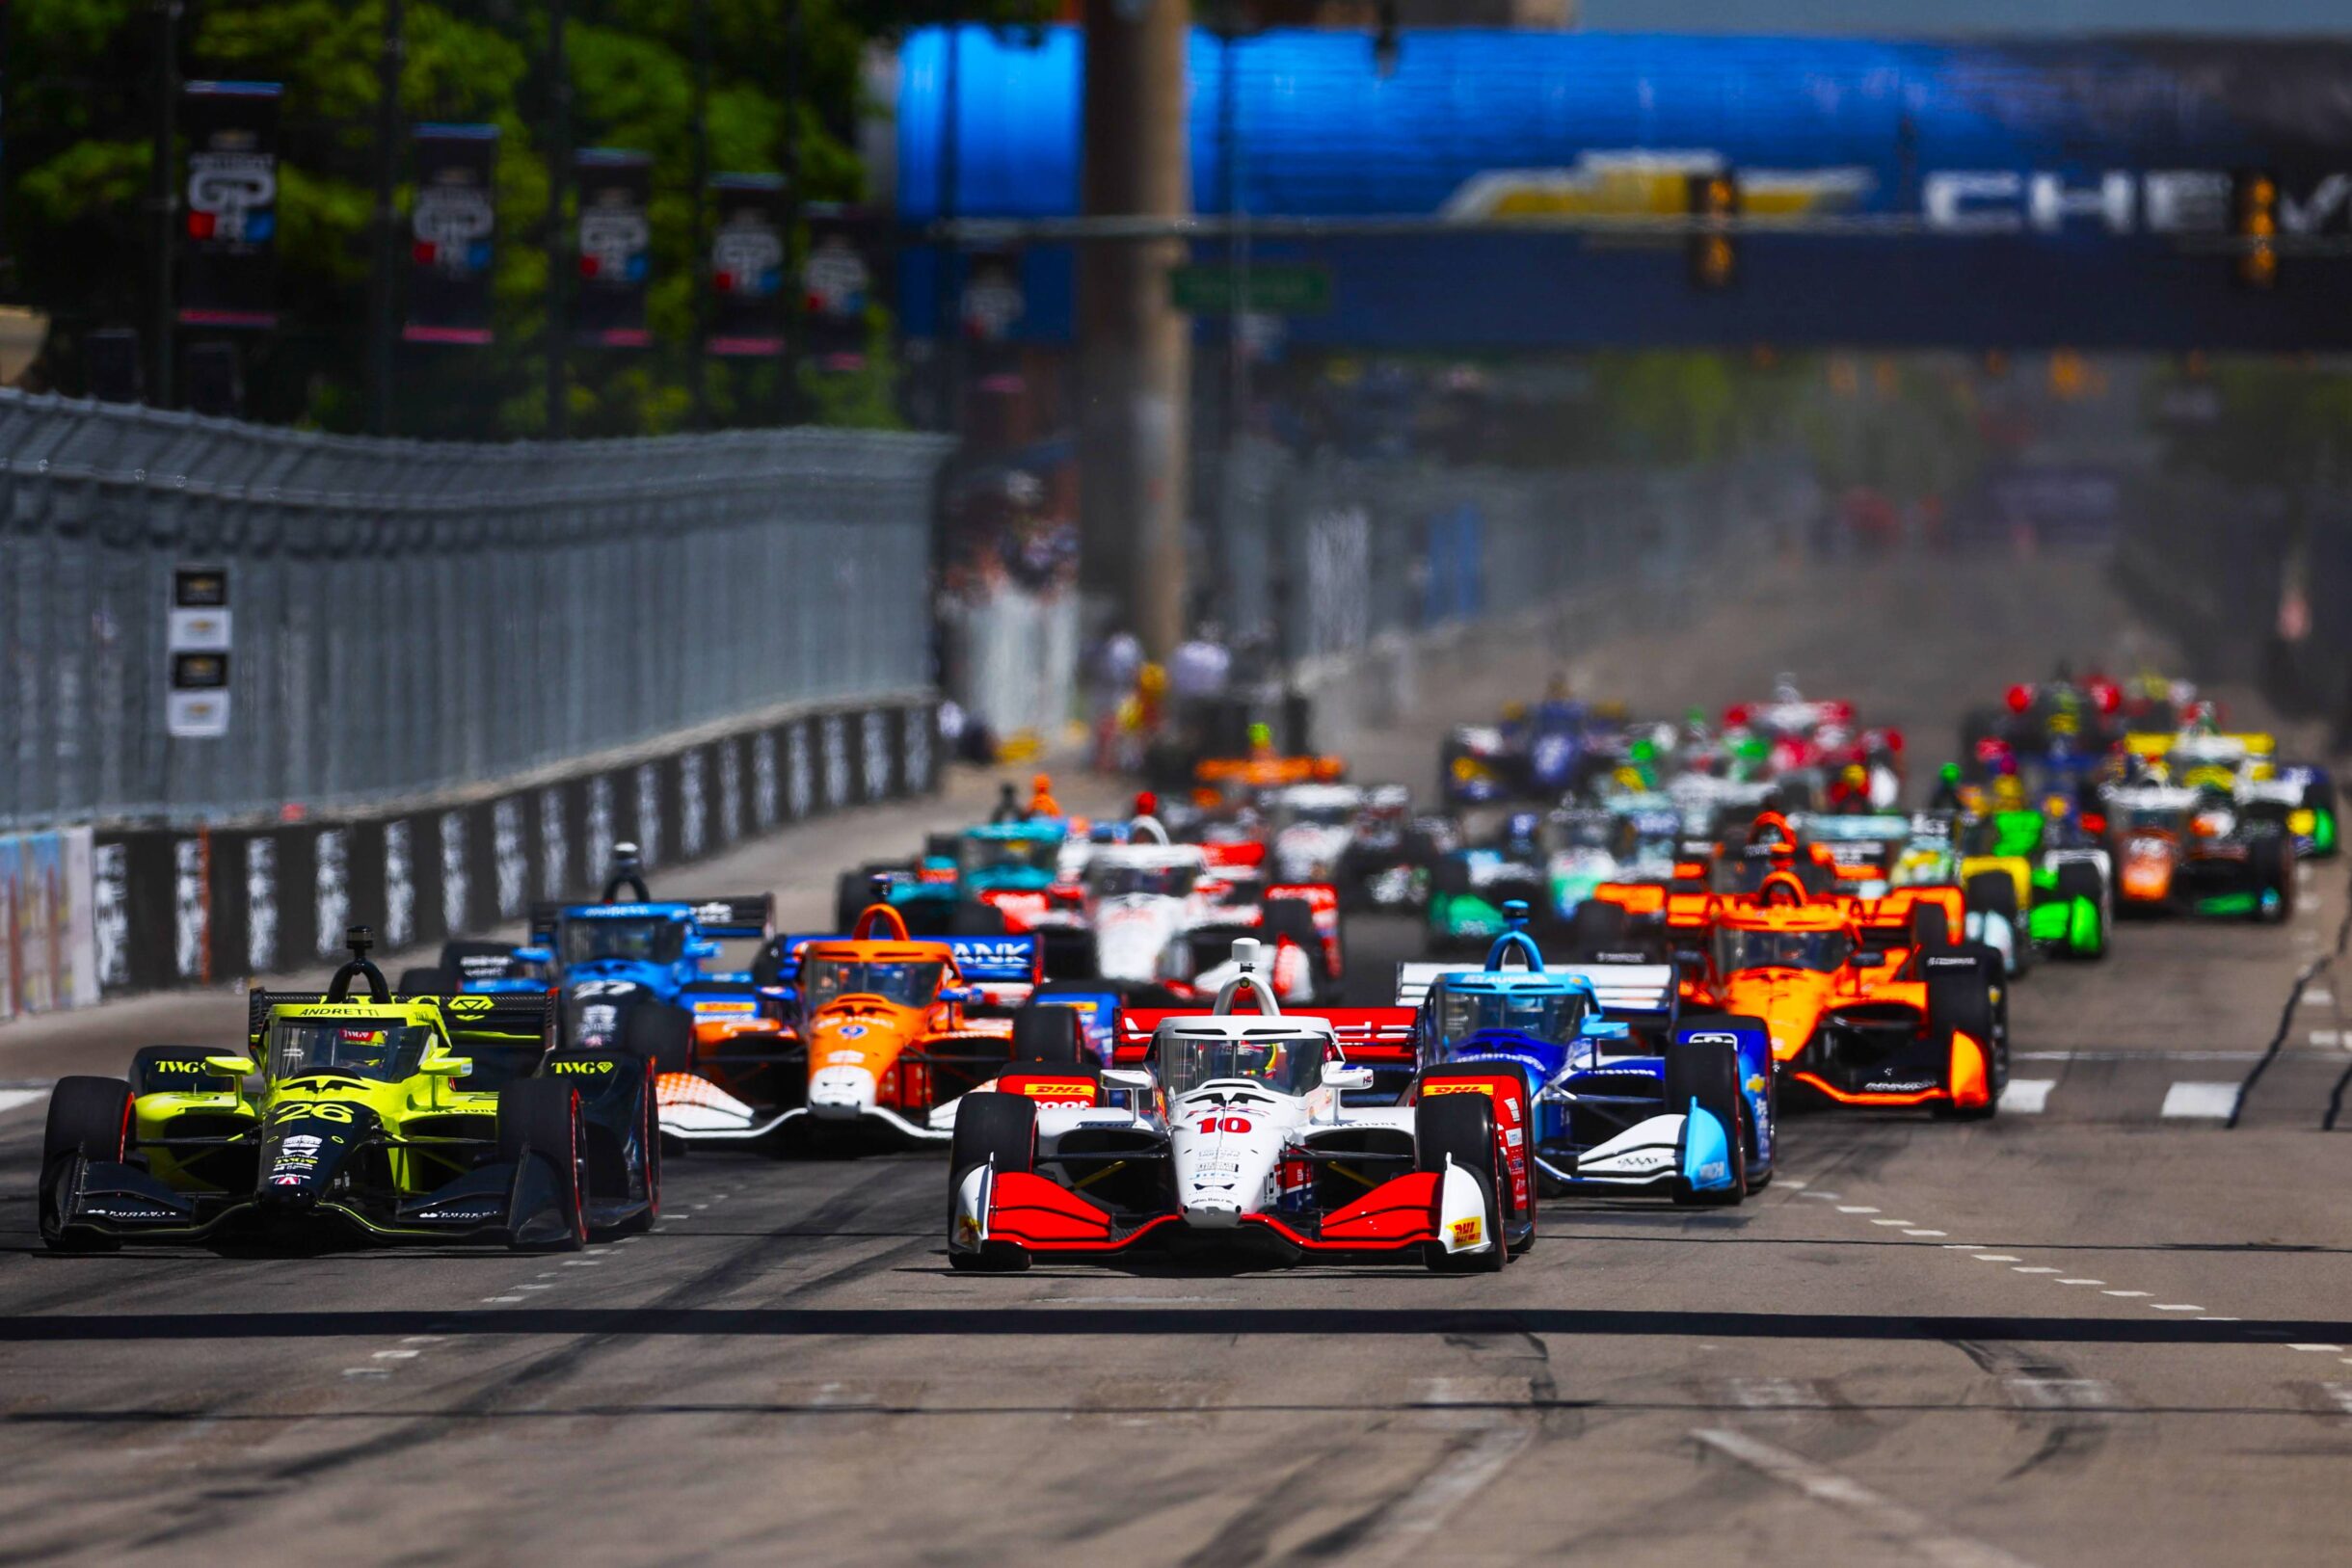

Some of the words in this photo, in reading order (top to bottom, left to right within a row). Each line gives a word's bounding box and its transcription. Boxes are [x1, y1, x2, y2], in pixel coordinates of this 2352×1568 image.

[953, 942, 1029, 965] ANK
[299, 1008, 380, 1018] ANDRETTI
[155, 1060, 199, 1074] TWG
[551, 1062, 596, 1075] TWG
[1034, 1085, 1084, 1094] DHL
[1433, 1086, 1482, 1095] DHL
[275, 1103, 355, 1126] 26
[1196, 1116, 1252, 1134] 10
[1454, 1221, 1476, 1236] DHL
